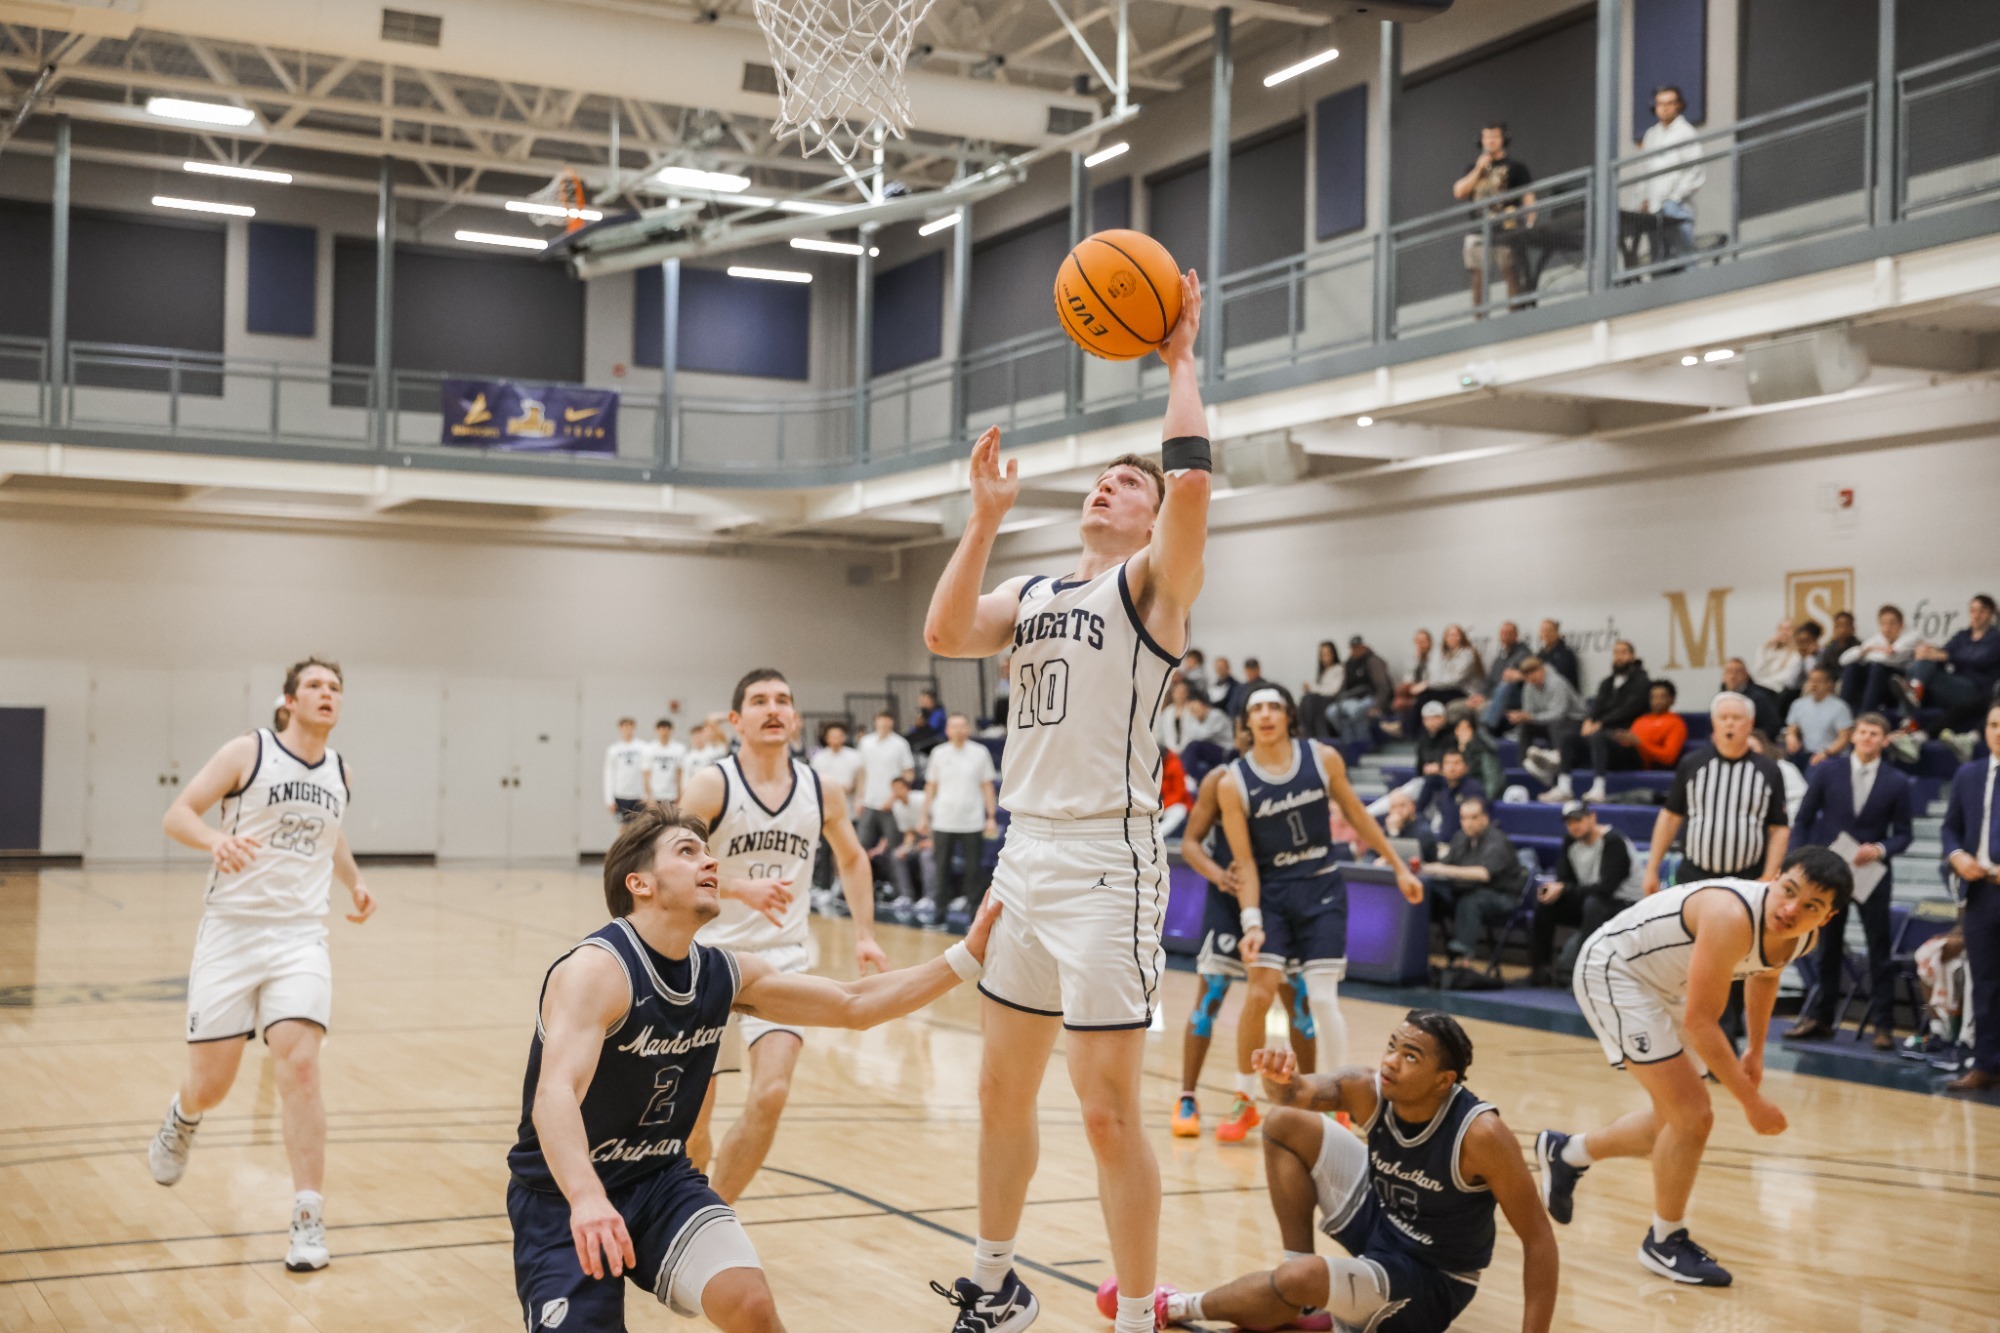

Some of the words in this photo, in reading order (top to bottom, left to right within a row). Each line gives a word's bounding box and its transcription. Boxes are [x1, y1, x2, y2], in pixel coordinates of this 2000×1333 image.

[1069, 296, 1109, 336] EVO
[1662, 587, 1734, 670] M
[1805, 586, 1837, 648] S
[1912, 600, 1958, 640] for
[1018, 658, 1069, 729] 10
[267, 781, 340, 818] KNIGHTS
[270, 811, 325, 857] 22
[727, 829, 809, 860] KNIGHTS
[1287, 811, 1308, 846] 1
[638, 1065, 684, 1126] 2
